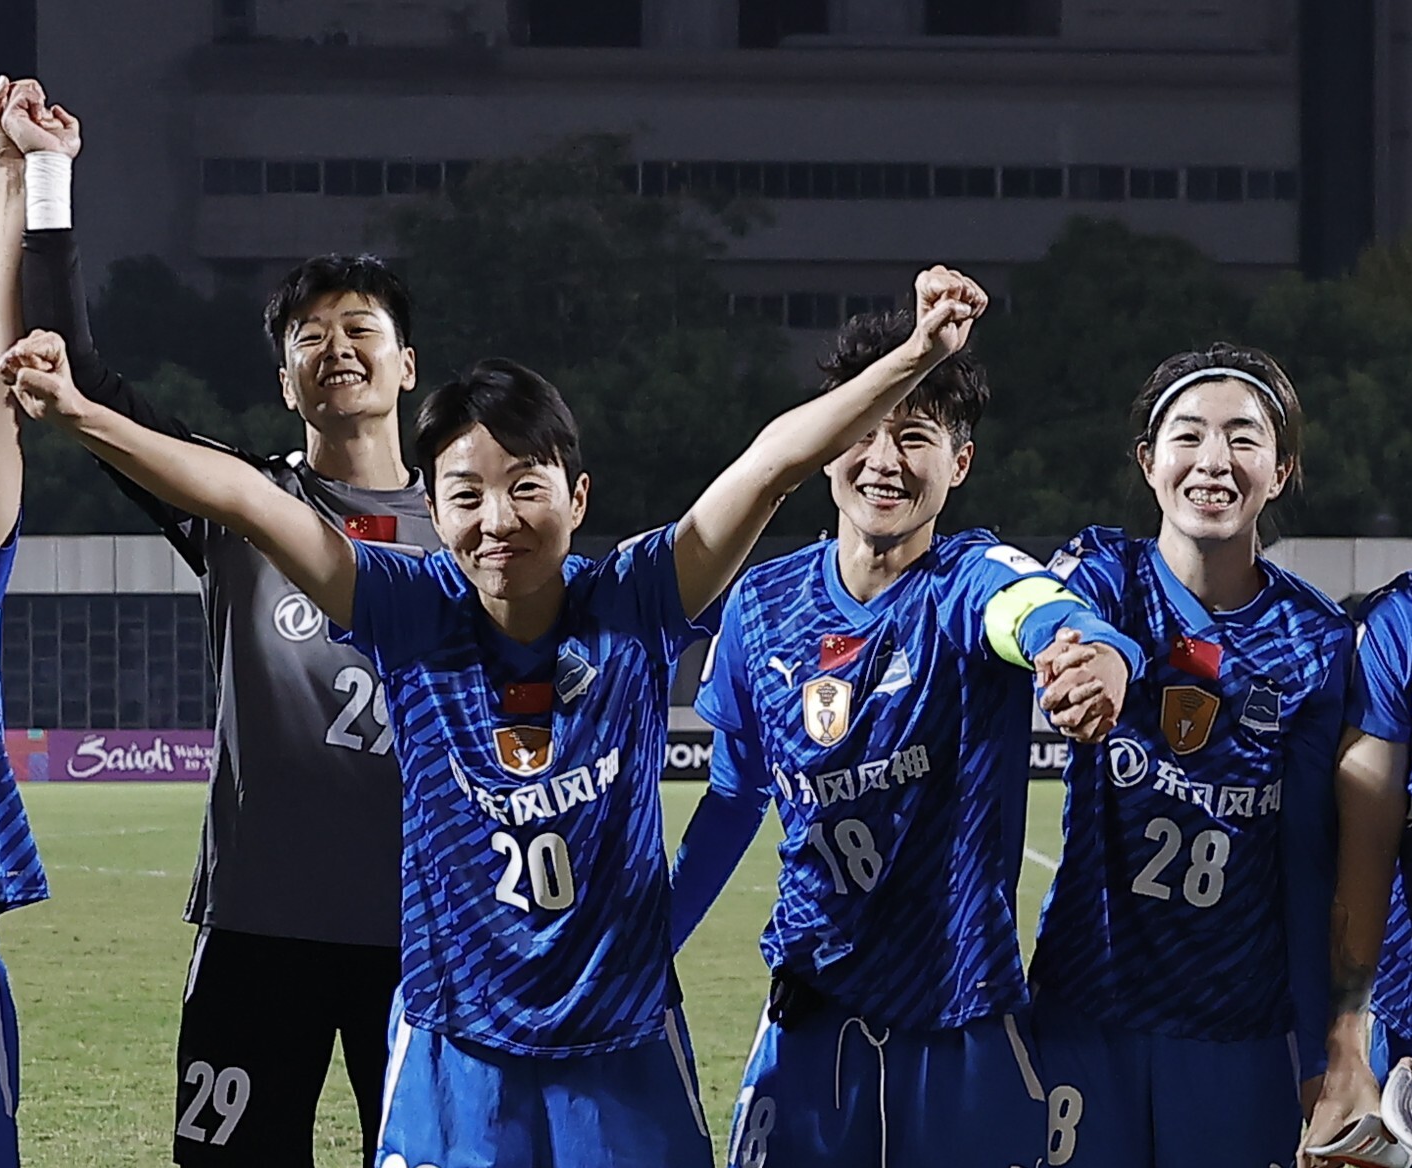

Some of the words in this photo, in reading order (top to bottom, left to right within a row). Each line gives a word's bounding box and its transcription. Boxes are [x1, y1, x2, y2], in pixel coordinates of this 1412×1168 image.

[67, 734, 175, 779] Saudi
[662, 743, 714, 769] OM
[1029, 743, 1069, 768] UE
[491, 831, 575, 912] 20
[807, 819, 883, 894] 18
[1131, 817, 1230, 907] 28
[176, 1060, 250, 1146] 29
